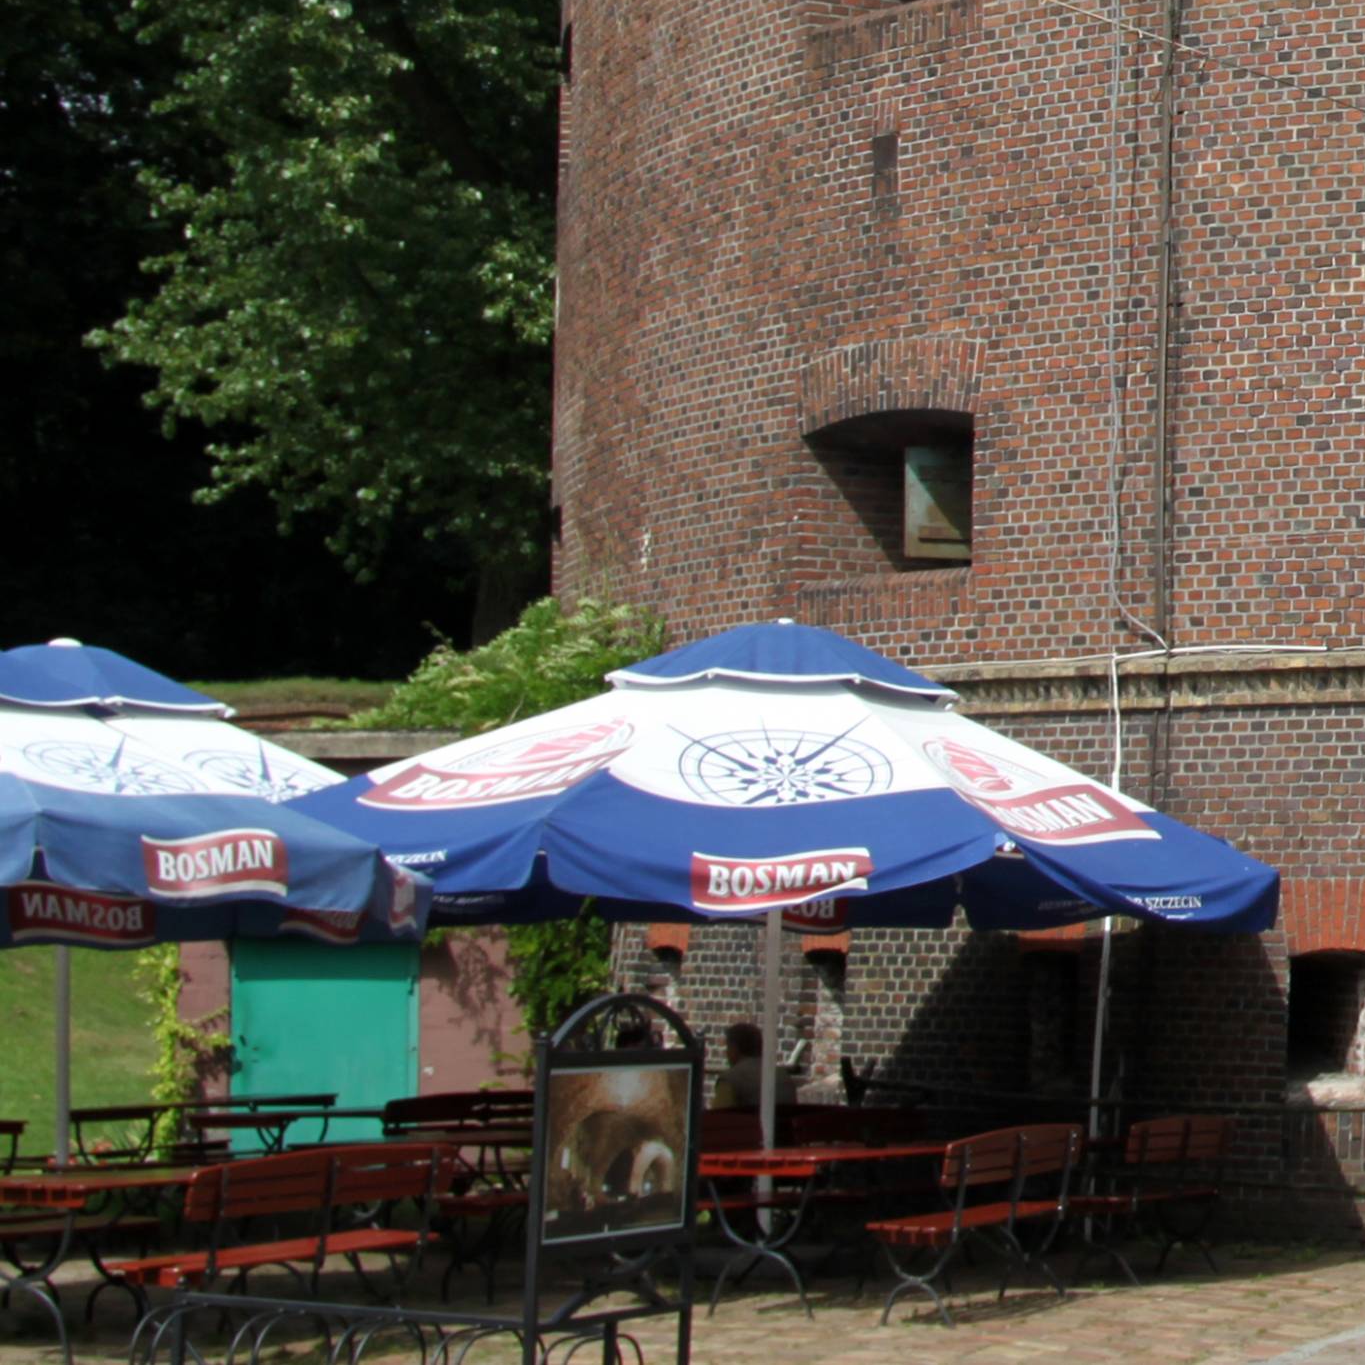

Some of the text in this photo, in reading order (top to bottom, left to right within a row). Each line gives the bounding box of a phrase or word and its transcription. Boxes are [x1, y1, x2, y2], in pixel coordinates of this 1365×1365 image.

[157, 839, 273, 882] BOSMAN
[707, 861, 857, 897] BOSMAN
[1144, 896, 1202, 910] SZCZECIN
